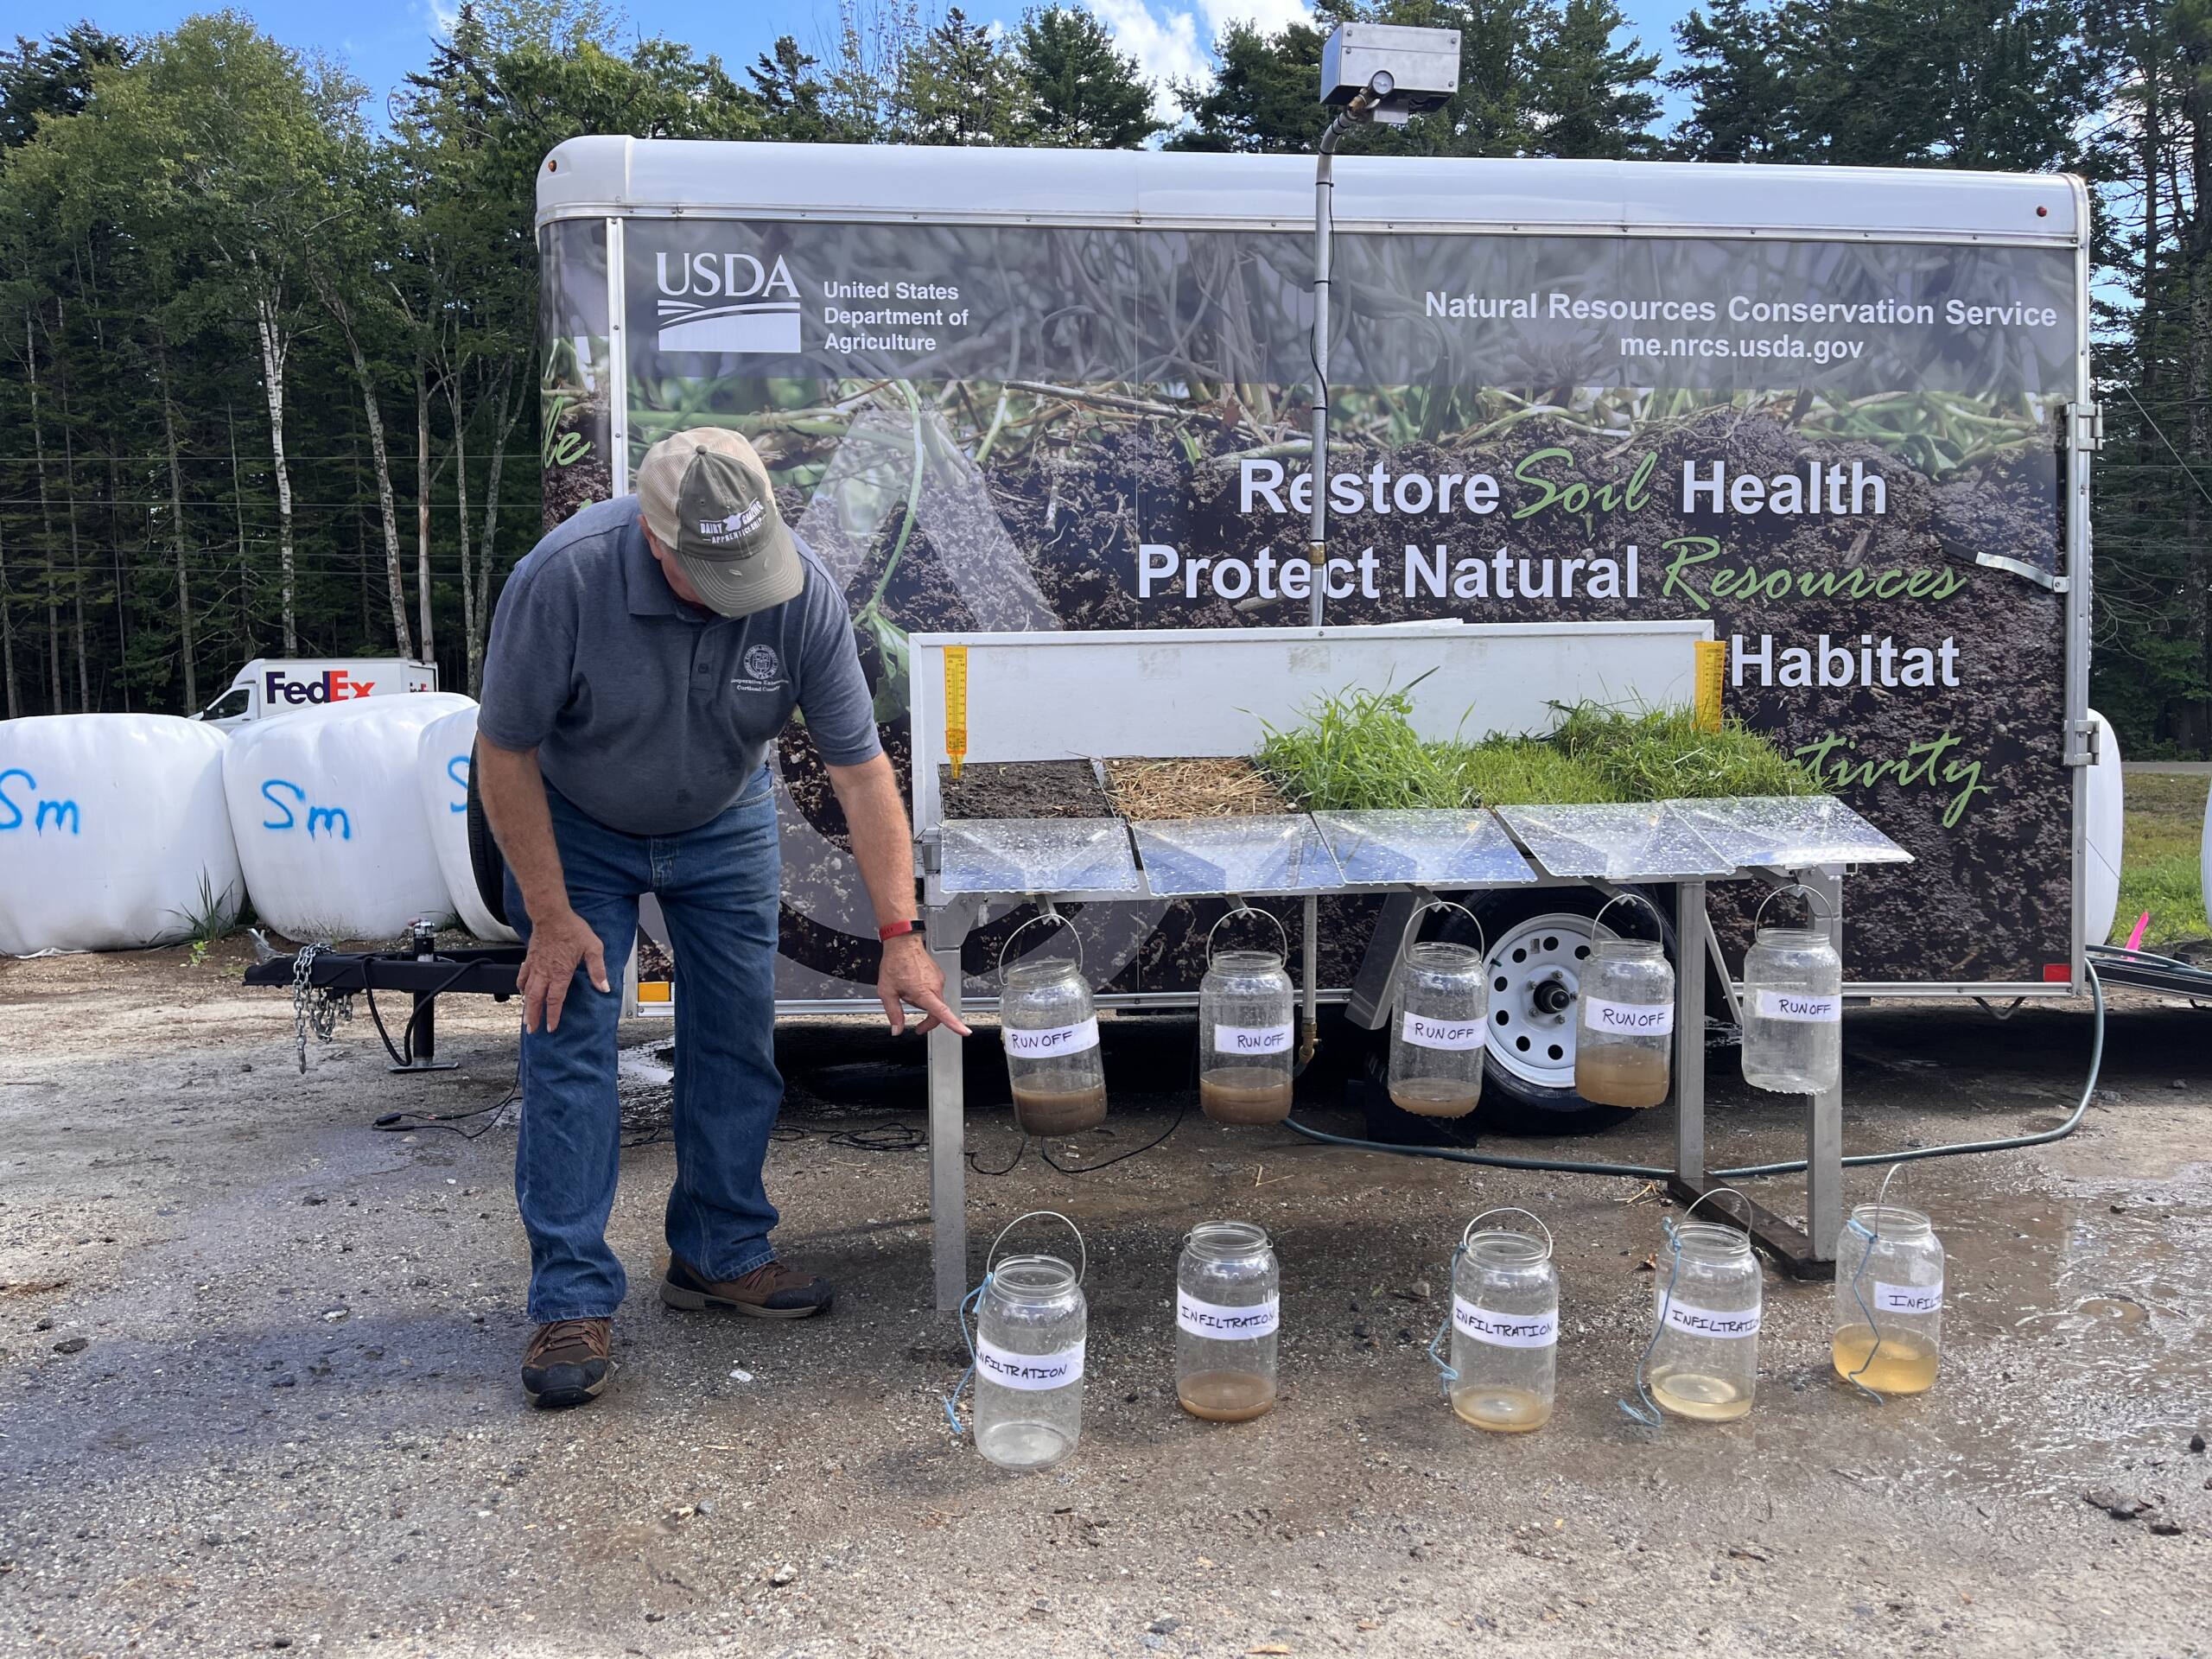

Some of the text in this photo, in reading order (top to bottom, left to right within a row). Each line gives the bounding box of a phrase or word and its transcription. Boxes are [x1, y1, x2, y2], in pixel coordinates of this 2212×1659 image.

[656, 251, 801, 298] USDA
[823, 281, 959, 300] United States
[824, 307, 969, 327] Department of
[1426, 291, 2057, 327] Natural Resources Conservation Service
[824, 333, 937, 354] Agriculture
[1620, 334, 1864, 363] me.nrcs.usda.gov
[1240, 448, 1886, 519] Restore Soil Health
[700, 522, 723, 534] DAIRY
[1138, 536, 1969, 611] Protect Natural Resources
[1732, 634, 1960, 687] Habitat
[265, 670, 376, 704] FedEx
[1787, 733, 1989, 829] tivity
[0, 767, 80, 836] Sm
[261, 779, 352, 841] Sm
[1181, 1306, 1274, 1329] INFILTRATION
[1456, 1307, 1554, 1337] INFILTRATION
